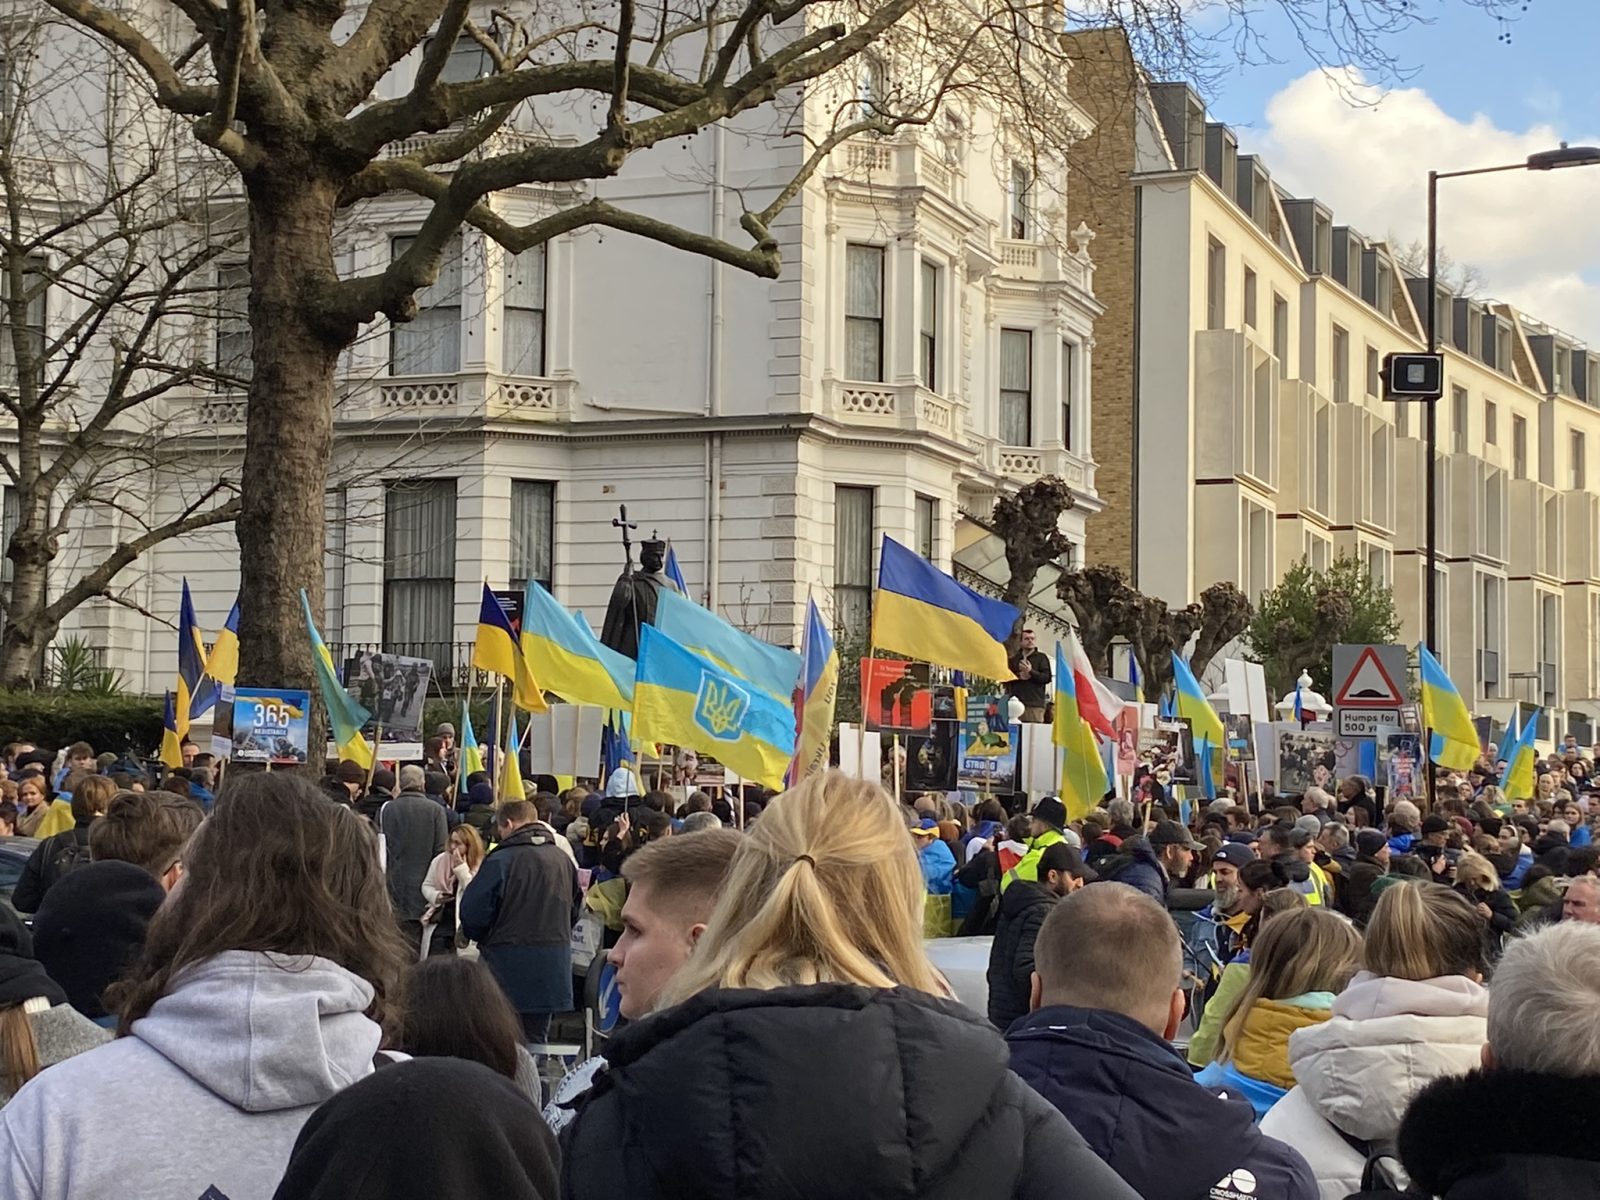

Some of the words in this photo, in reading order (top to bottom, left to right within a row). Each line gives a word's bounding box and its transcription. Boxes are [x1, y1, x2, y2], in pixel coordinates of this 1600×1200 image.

[253, 704, 290, 727] 365
[1345, 713, 1377, 722] Humps
[1345, 723, 1365, 731] 500
